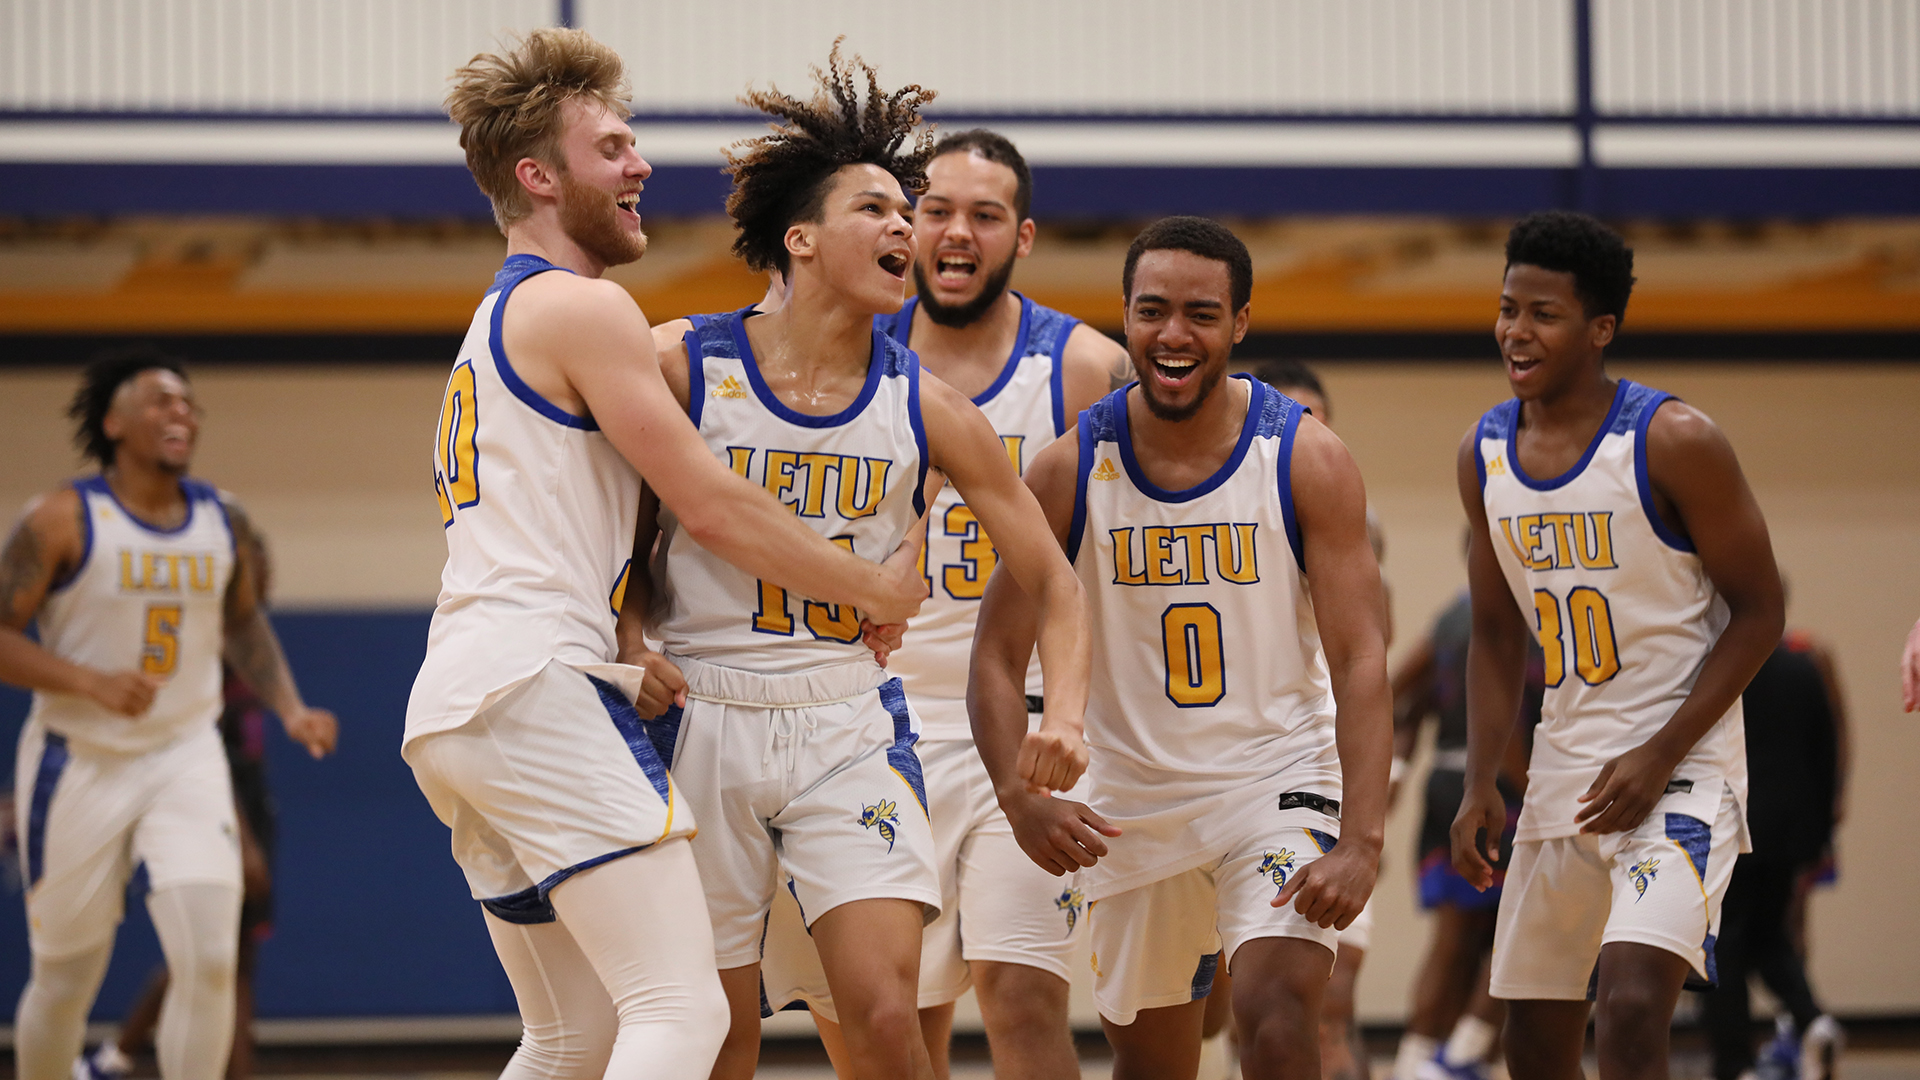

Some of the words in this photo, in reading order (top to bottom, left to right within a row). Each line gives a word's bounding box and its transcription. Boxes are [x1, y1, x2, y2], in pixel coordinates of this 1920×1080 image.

[711, 389, 748, 399] adidas
[433, 358, 481, 530] 0
[118, 550, 215, 592] LETU
[1109, 523, 1260, 585] LETU
[140, 603, 183, 678] 5
[1161, 602, 1226, 708] 0
